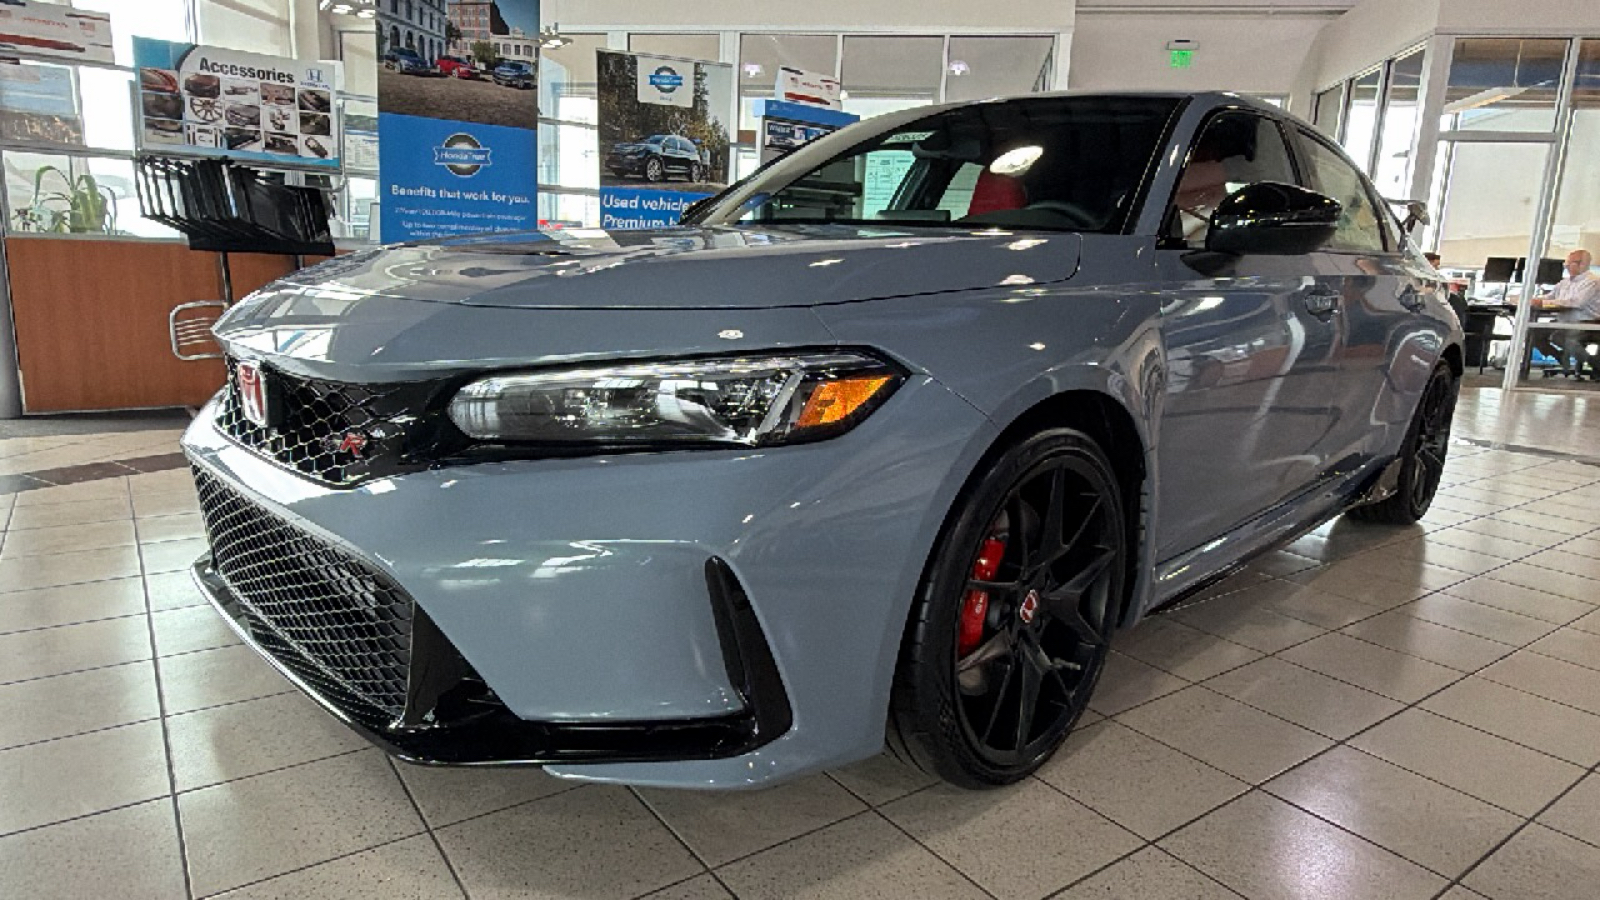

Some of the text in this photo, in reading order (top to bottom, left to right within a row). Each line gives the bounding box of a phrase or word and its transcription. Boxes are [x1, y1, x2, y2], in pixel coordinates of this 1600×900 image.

[199, 57, 295, 84] Accessories
[391, 184, 437, 198] Benefits
[439, 186, 461, 200] that
[462, 189, 489, 202] work
[492, 190, 506, 202] for
[603, 194, 640, 209] Used
[603, 214, 665, 229] Premium
